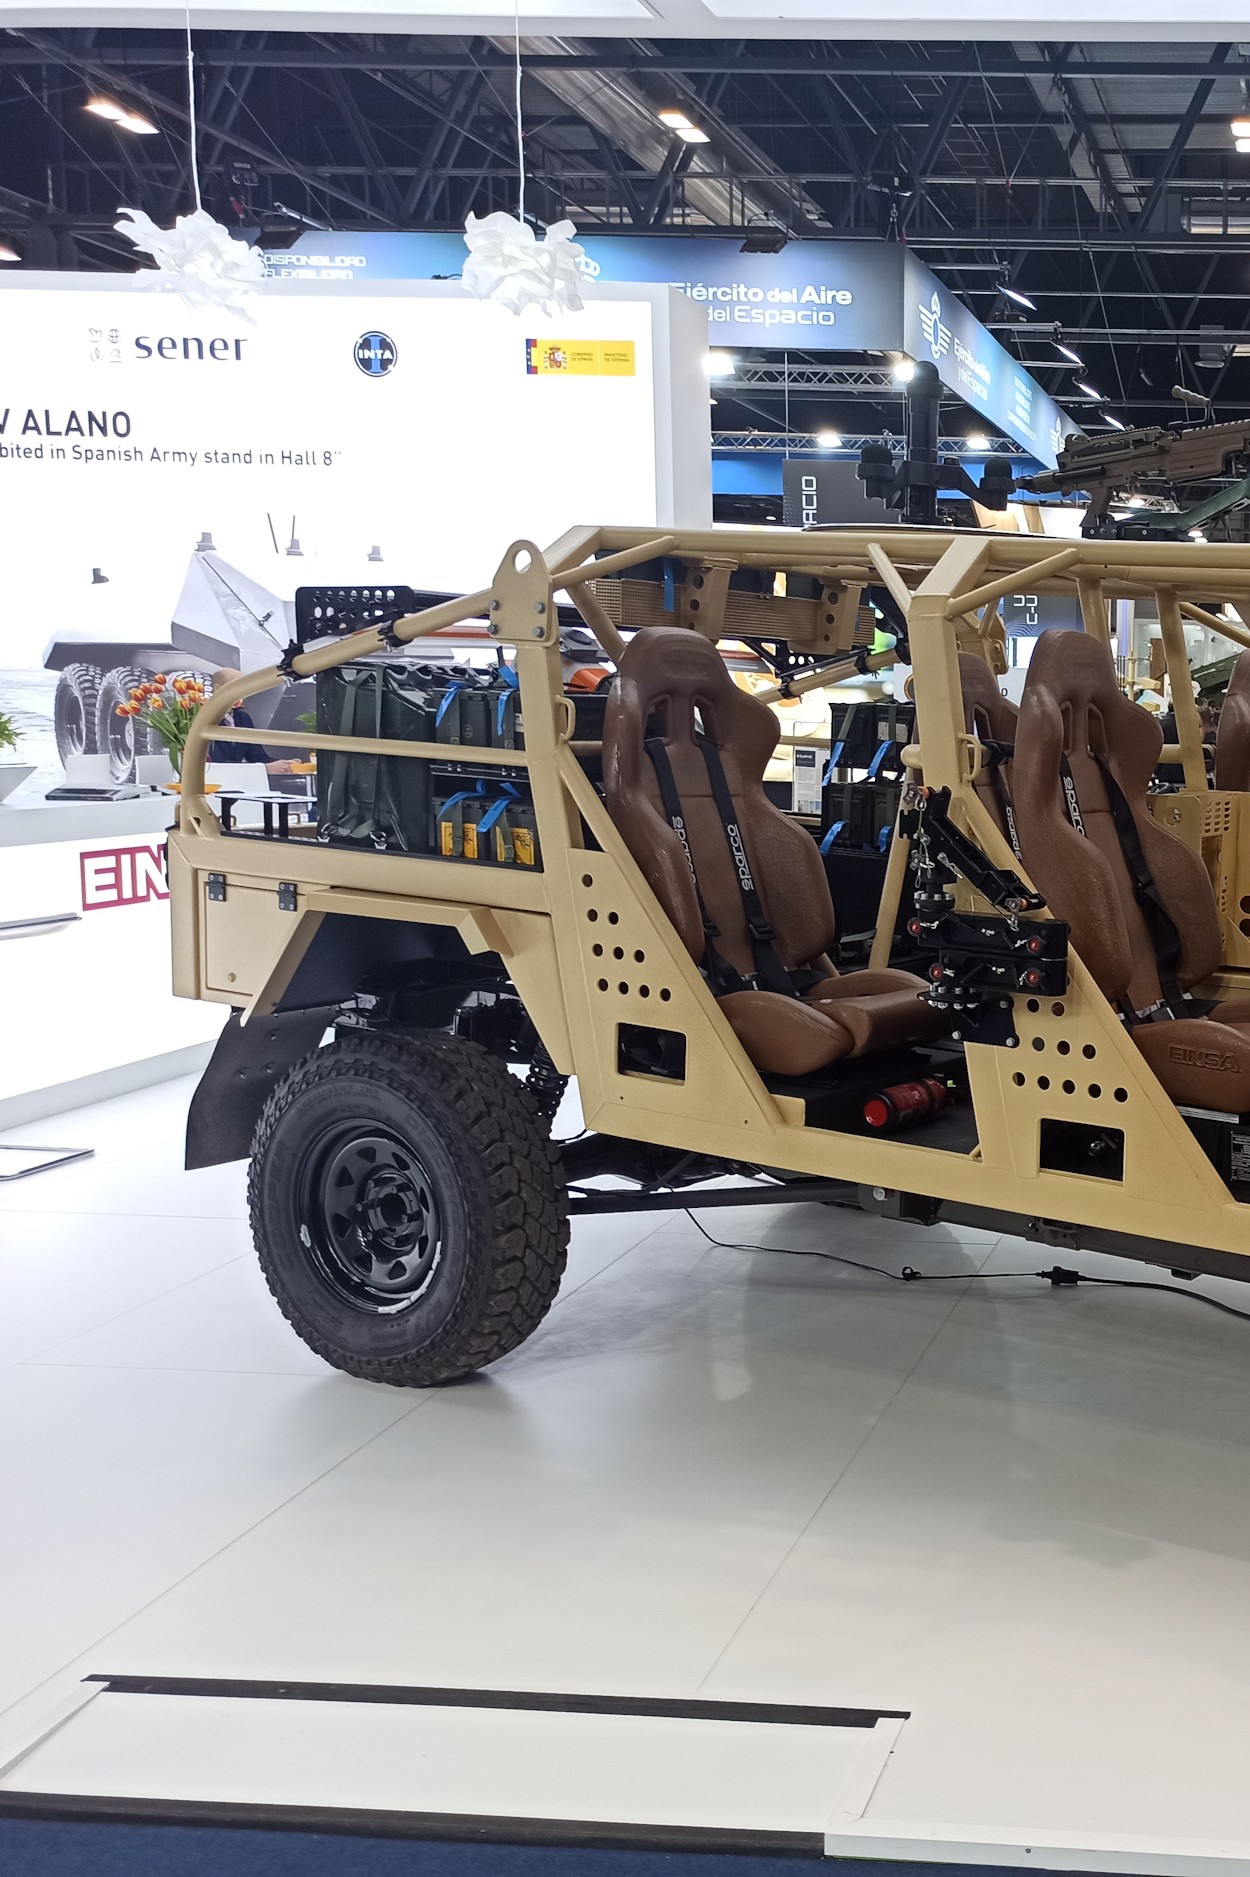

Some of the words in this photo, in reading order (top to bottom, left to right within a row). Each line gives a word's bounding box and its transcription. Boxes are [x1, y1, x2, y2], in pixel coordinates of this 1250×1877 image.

[767, 287, 798, 303] del
[799, 285, 853, 305] Aire
[734, 306, 835, 328] Espacio
[135, 336, 248, 361] sener
[359, 349, 393, 360] INTA
[21, 408, 131, 438] ALANO
[50, 444, 66, 459] in
[72, 444, 143, 464] Spanish
[150, 447, 198, 467] Army
[204, 449, 252, 464] stand
[259, 449, 275, 464] in
[281, 450, 317, 466] Hall
[1062, 775, 1086, 838] sparc
[727, 823, 755, 892] sparco
[1168, 1043, 1242, 1074] EINSA
